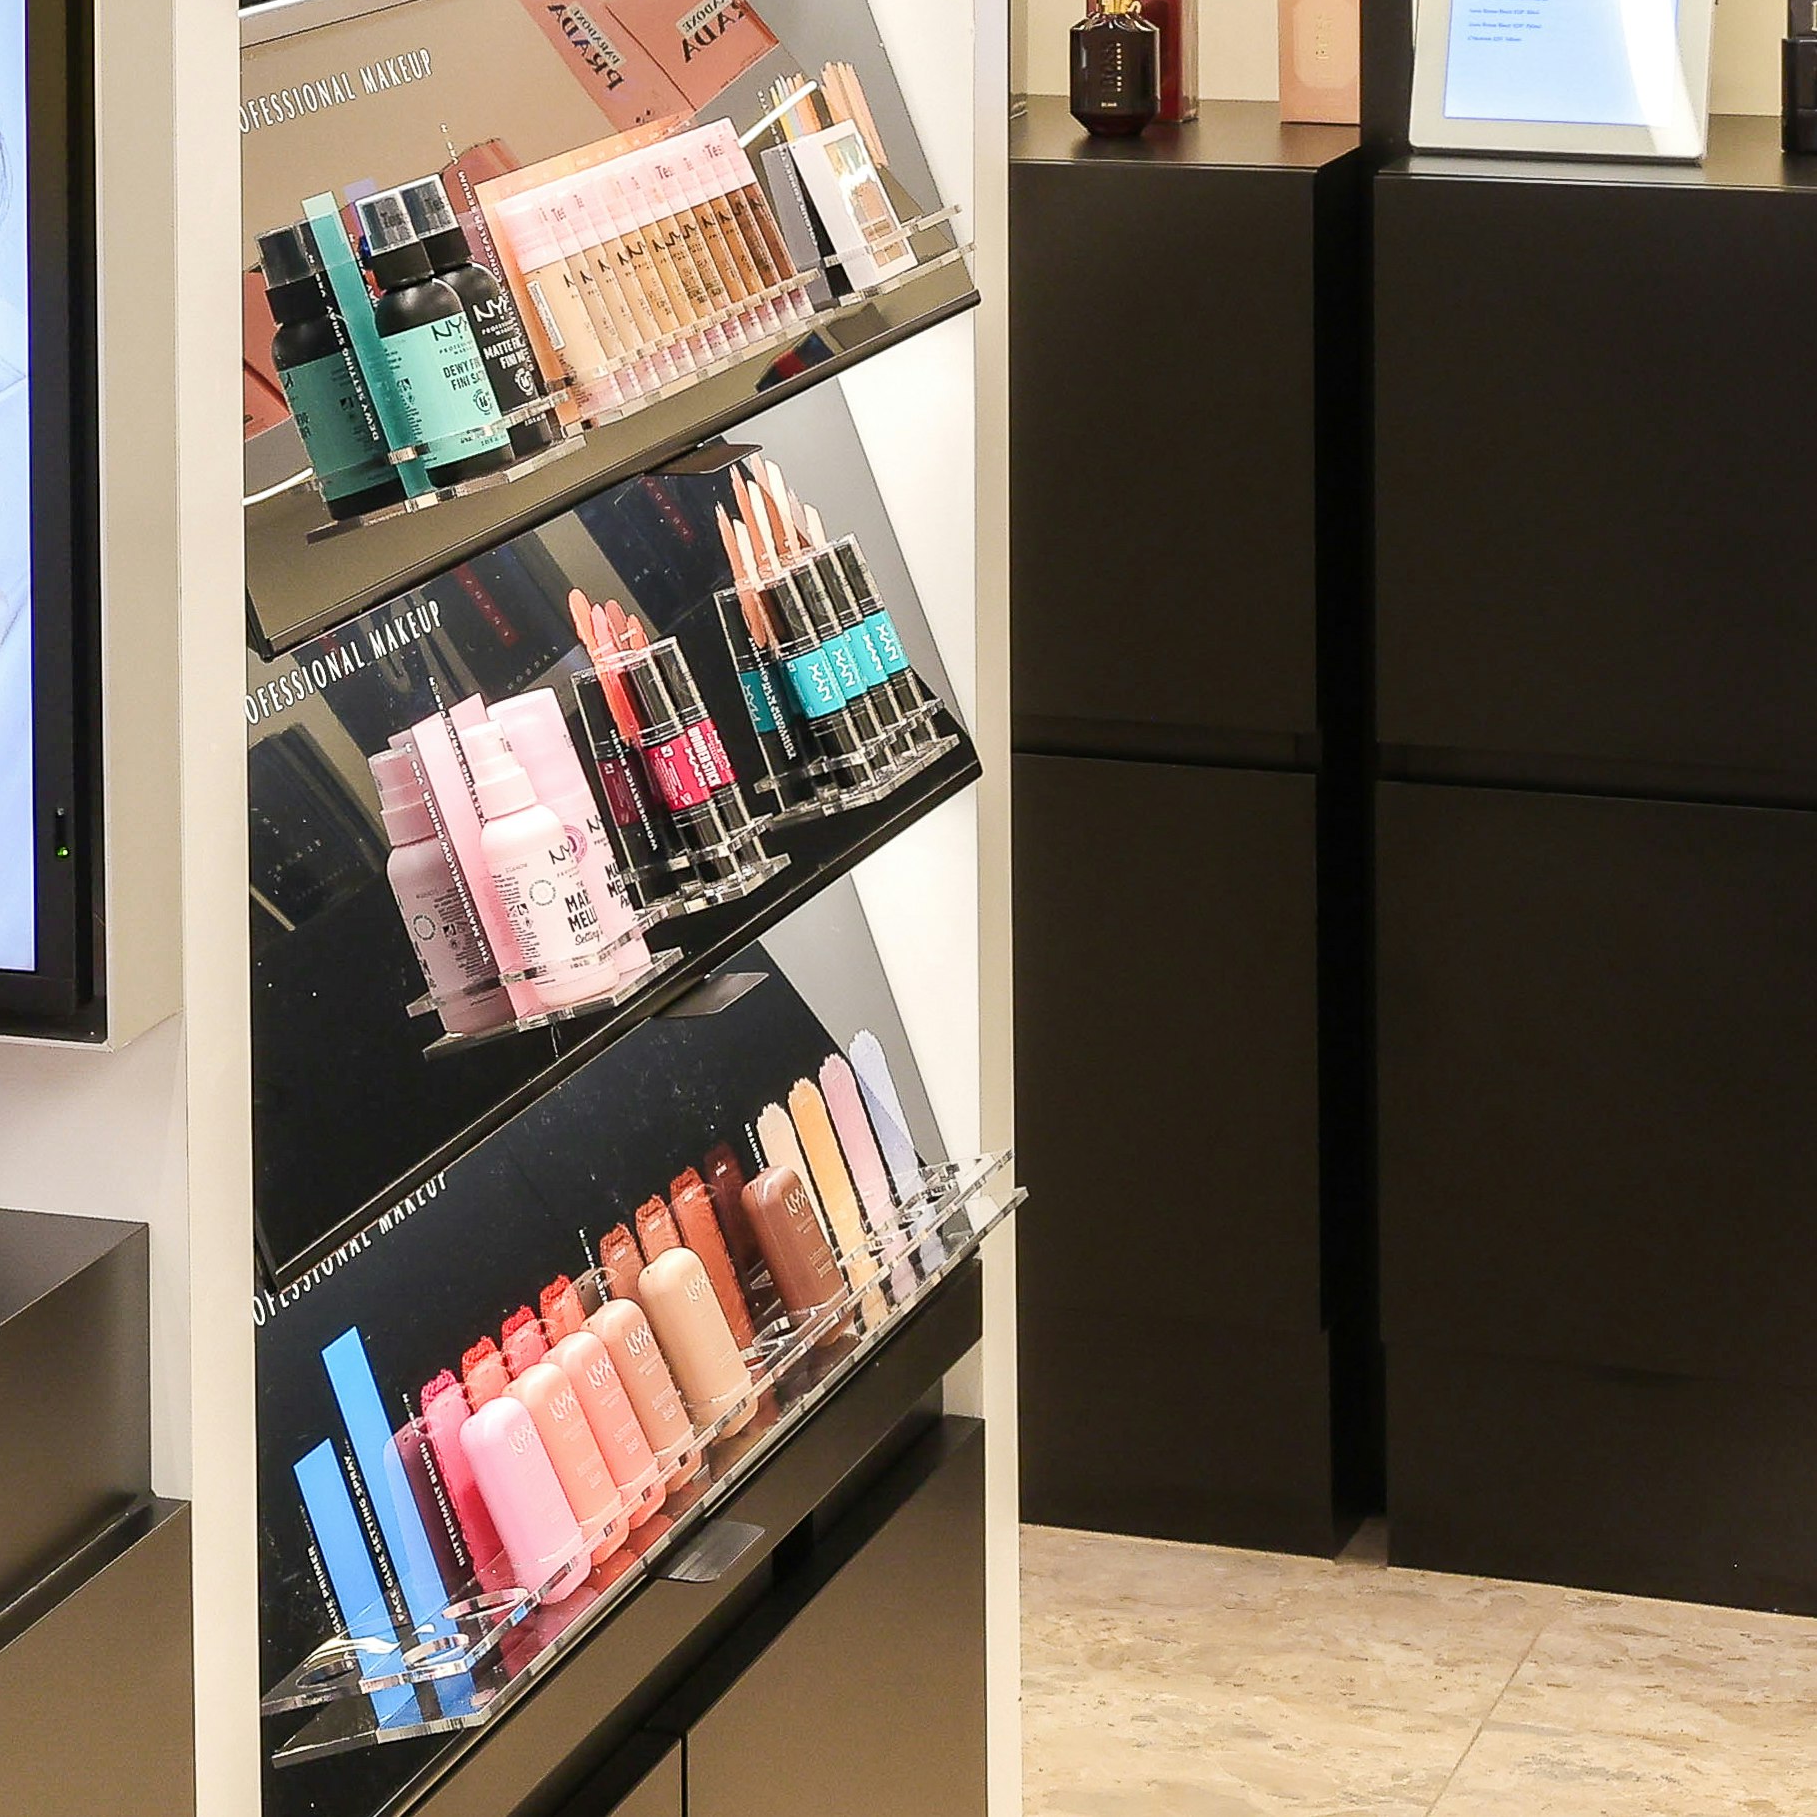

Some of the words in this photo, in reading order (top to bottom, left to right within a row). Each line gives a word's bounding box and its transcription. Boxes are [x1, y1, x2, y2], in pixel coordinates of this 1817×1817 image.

[361, 45, 433, 97] MAKEUP
[443, 360, 470, 378] DEWY
[451, 376, 471, 391] FINI
[369, 598, 443, 661] MAKEUP
[875, 623, 899, 662] NYX
[807, 663, 834, 702] NYX
[832, 648, 855, 688] NYX
[584, 1356, 617, 1392] NYX
[343, 1455, 362, 1497] SPRAY
[419, 1442, 437, 1484] BLUSH
[358, 1498, 382, 1553] SETTING
[433, 1485, 465, 1567] BUTTERMELT
[307, 1545, 330, 1599] PRIMER
[377, 1555, 393, 1588] GLUE
[389, 1589, 406, 1622] FACE
